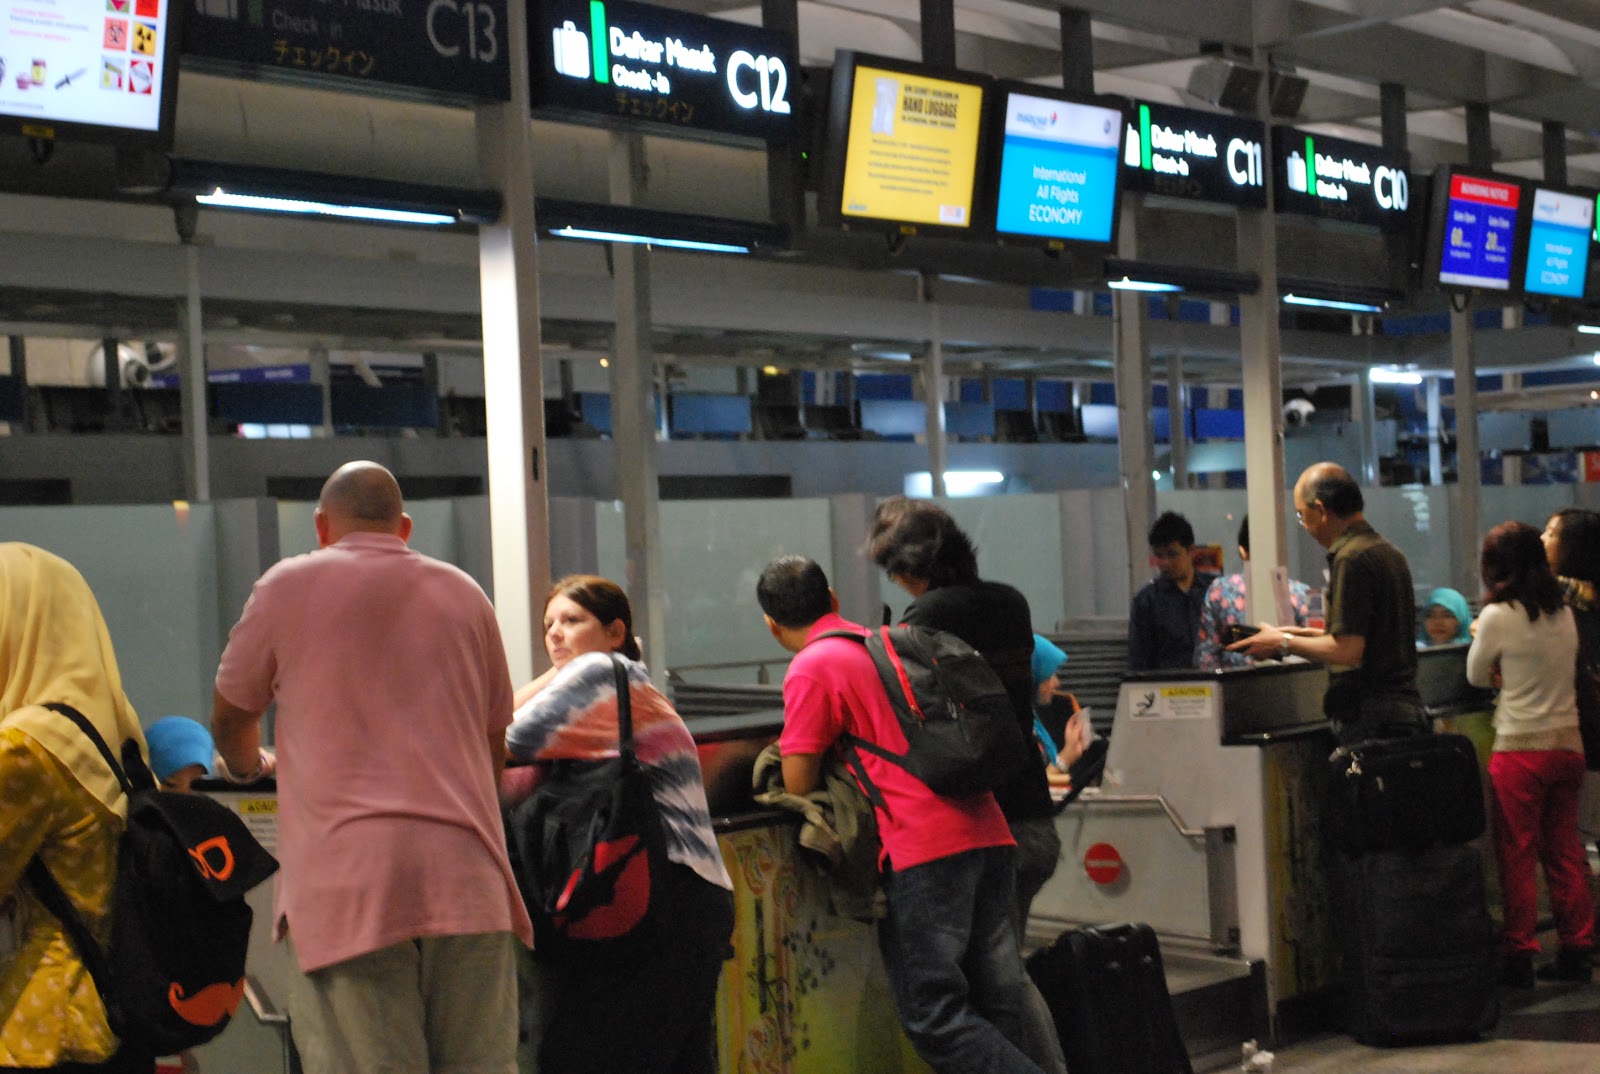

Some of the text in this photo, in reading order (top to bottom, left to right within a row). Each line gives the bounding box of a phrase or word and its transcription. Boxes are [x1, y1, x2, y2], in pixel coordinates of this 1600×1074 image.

[344, 0, 403, 18] asuk
[426, 0, 498, 63] C13
[609, 26, 716, 74] Daftar Masuk
[727, 50, 791, 114] C12
[1032, 164, 1087, 185] International
[1227, 138, 1262, 186] C11
[1036, 184, 1079, 205] All Flights
[1374, 166, 1408, 211] C10
[1029, 203, 1083, 225] ECONOMY
